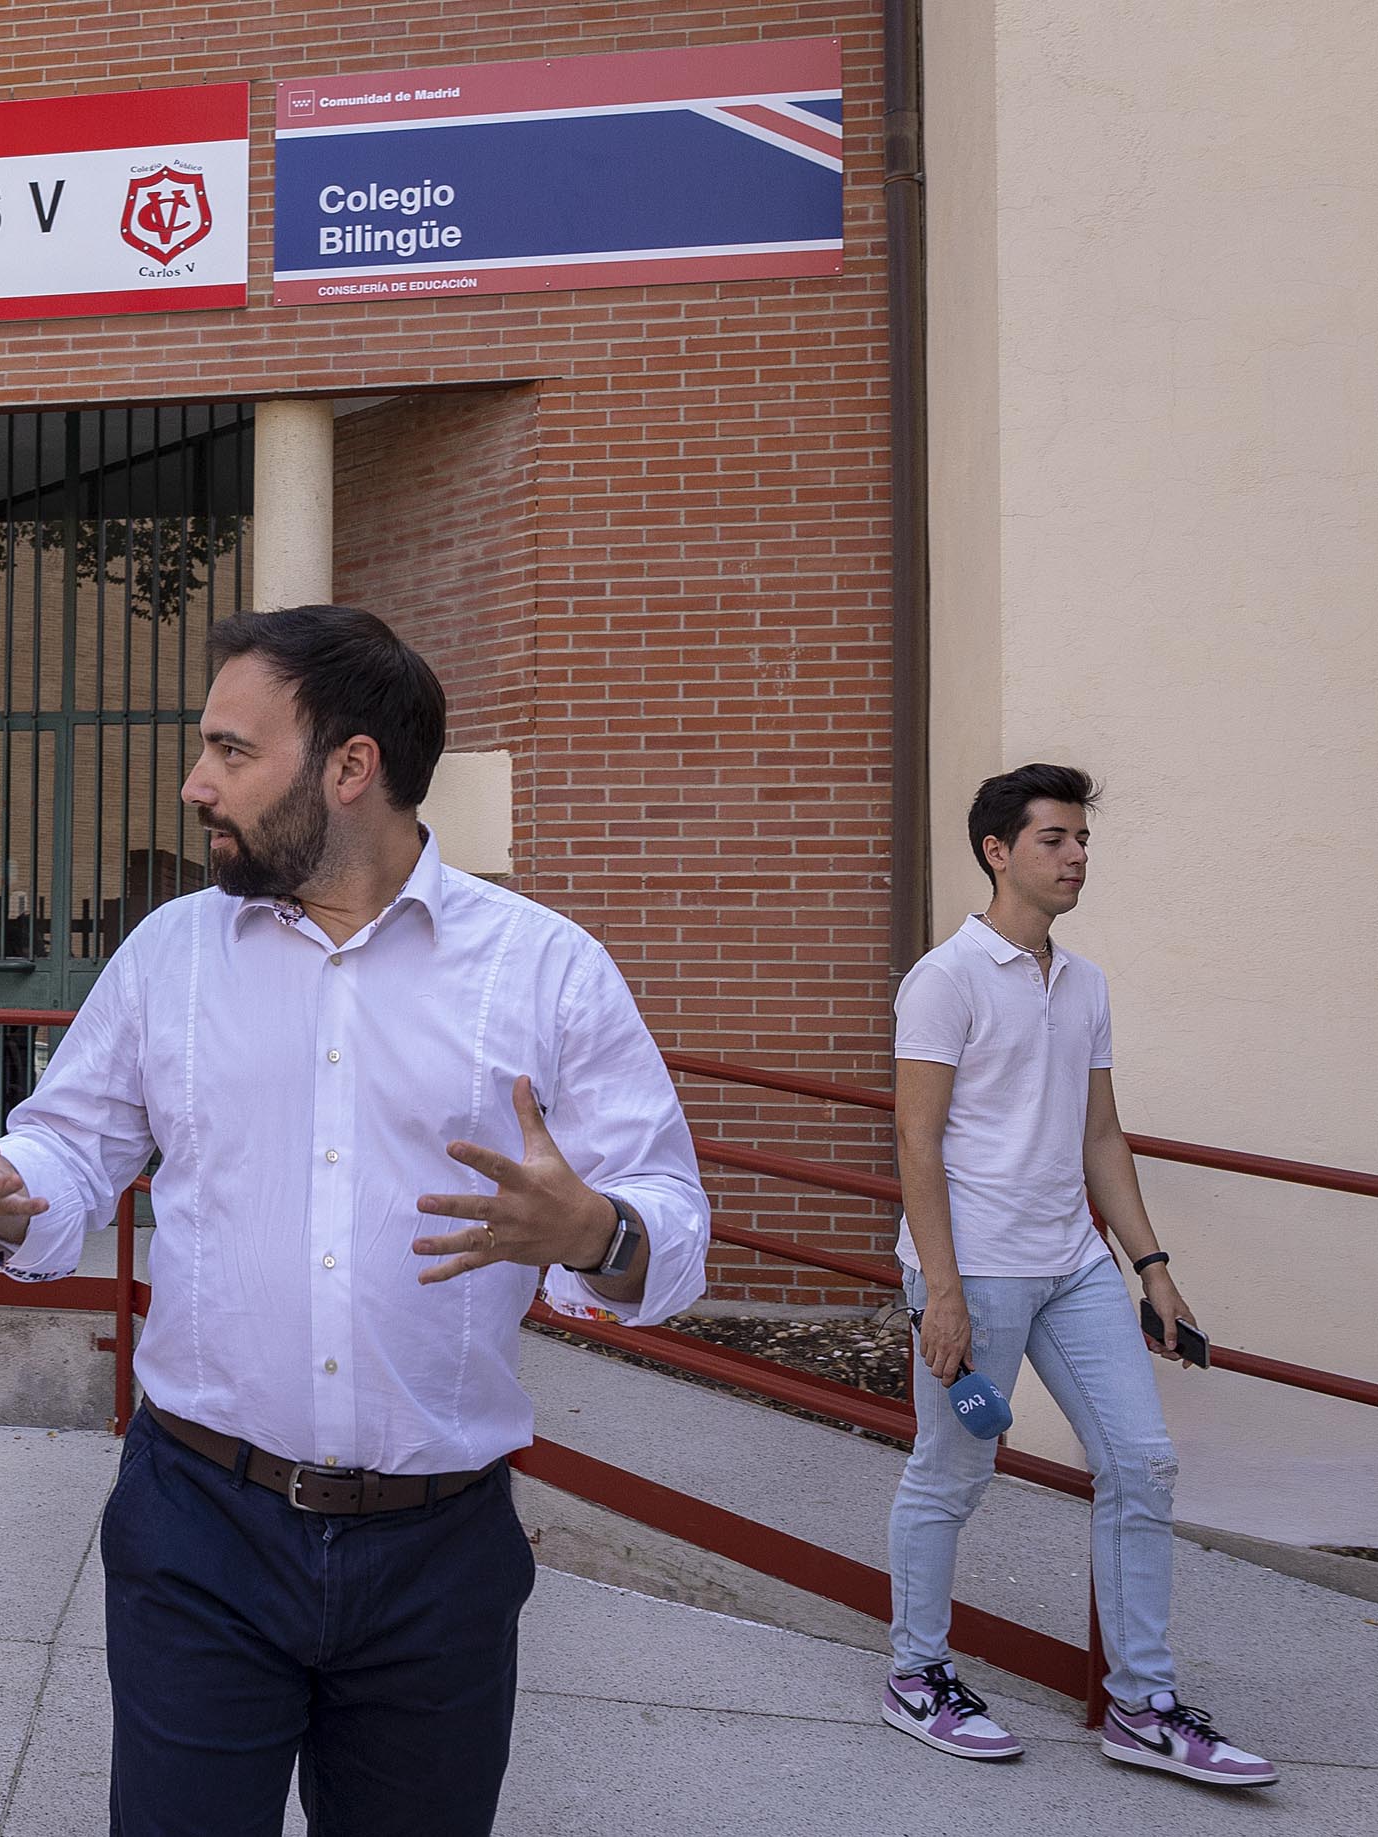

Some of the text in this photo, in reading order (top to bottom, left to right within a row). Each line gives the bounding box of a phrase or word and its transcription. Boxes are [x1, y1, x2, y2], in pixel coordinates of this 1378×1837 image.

[319, 87, 461, 108] Comunidad de Madrid
[28, 179, 66, 233] V
[318, 179, 455, 215] Colegio
[319, 220, 462, 257] Bilingüe
[138, 262, 196, 278] Carlos V
[318, 277, 478, 296] CONSEJERÍA DE EDUCACIÓN
[957, 1394, 986, 1414] tve
